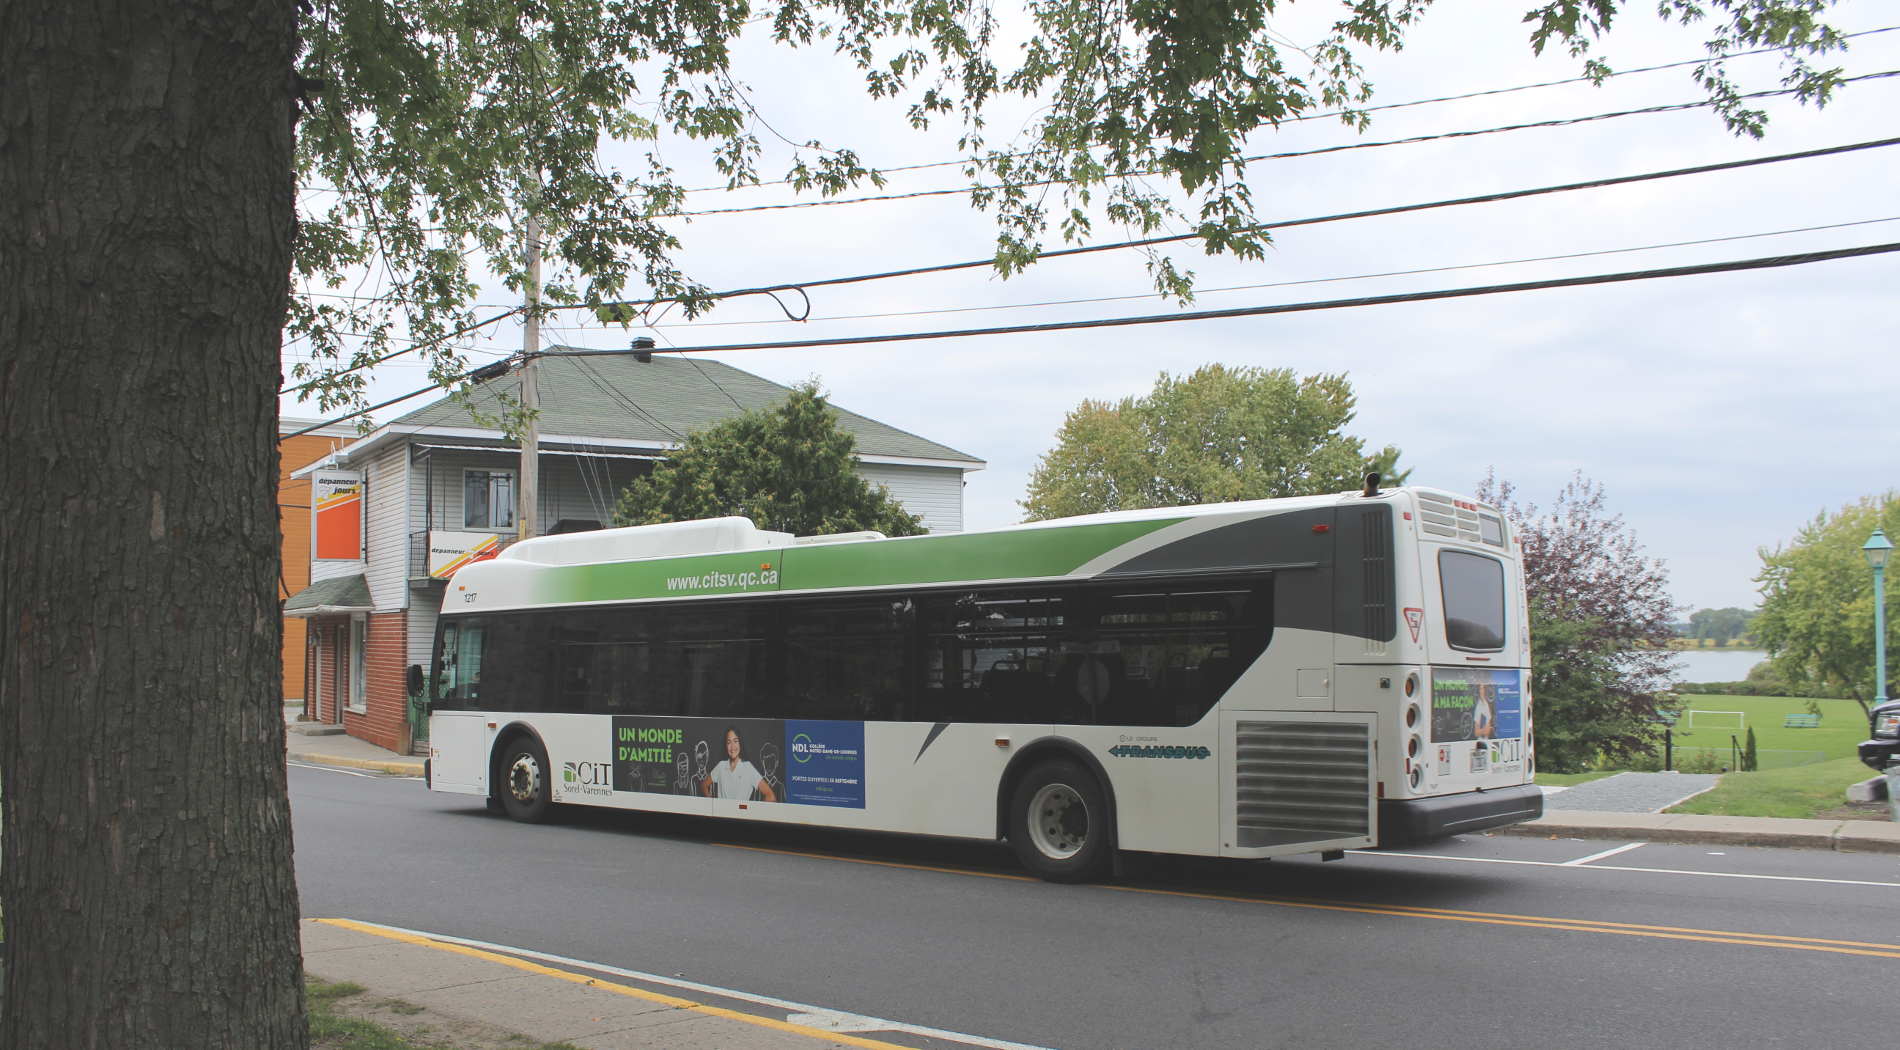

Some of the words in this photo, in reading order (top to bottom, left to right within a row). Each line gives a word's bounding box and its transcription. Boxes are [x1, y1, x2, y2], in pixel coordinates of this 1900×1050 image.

[667, 570, 778, 590] www.citsv.qc.ca
[619, 728, 635, 742] UN
[639, 728, 683, 744] MONDE
[619, 745, 672, 763] D'AMITIÉ
[792, 744, 809, 753] NDL
[1117, 745, 1211, 759] TRANSBUS
